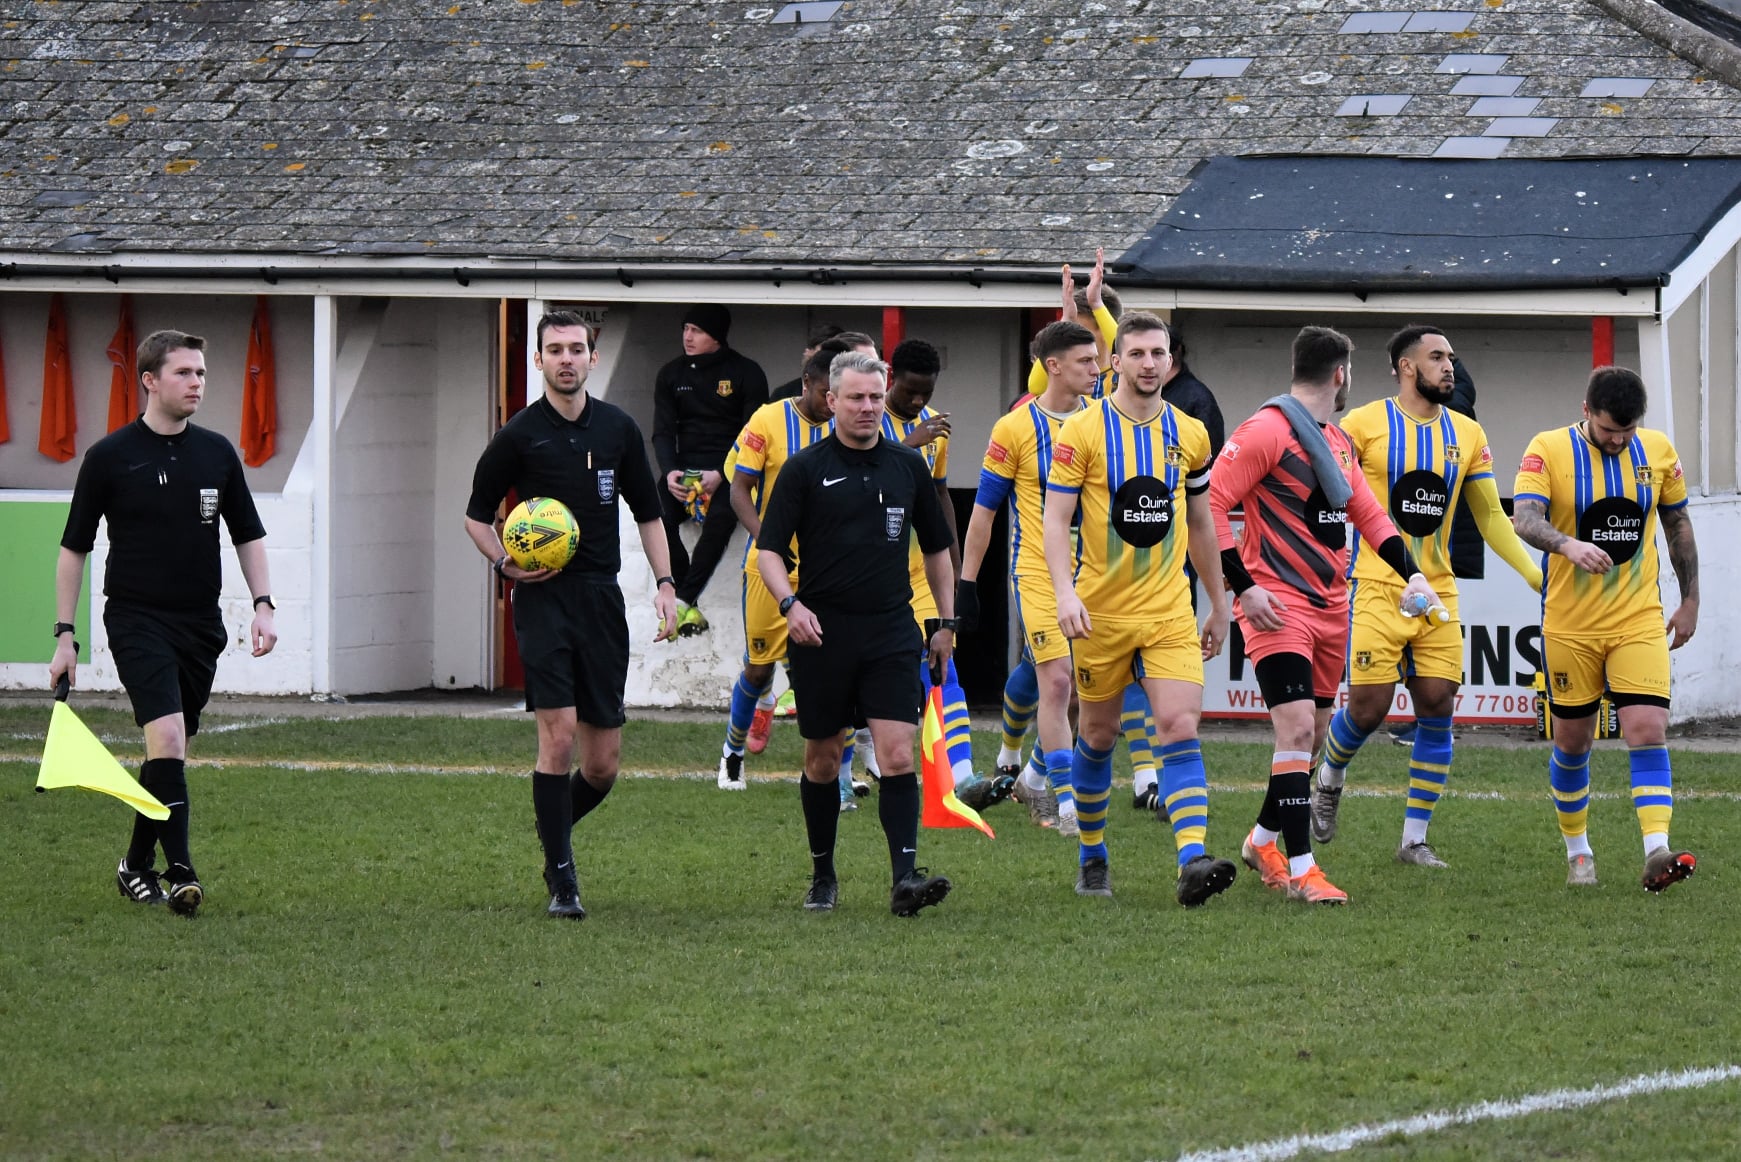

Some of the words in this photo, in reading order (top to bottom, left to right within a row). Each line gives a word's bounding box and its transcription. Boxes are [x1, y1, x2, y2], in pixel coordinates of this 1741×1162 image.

[1415, 488, 1446, 503] Quinn
[1402, 500, 1444, 516] Estates
[1123, 509, 1169, 523] Estates
[1607, 514, 1641, 528] Quinn
[1591, 529, 1639, 542] Estates
